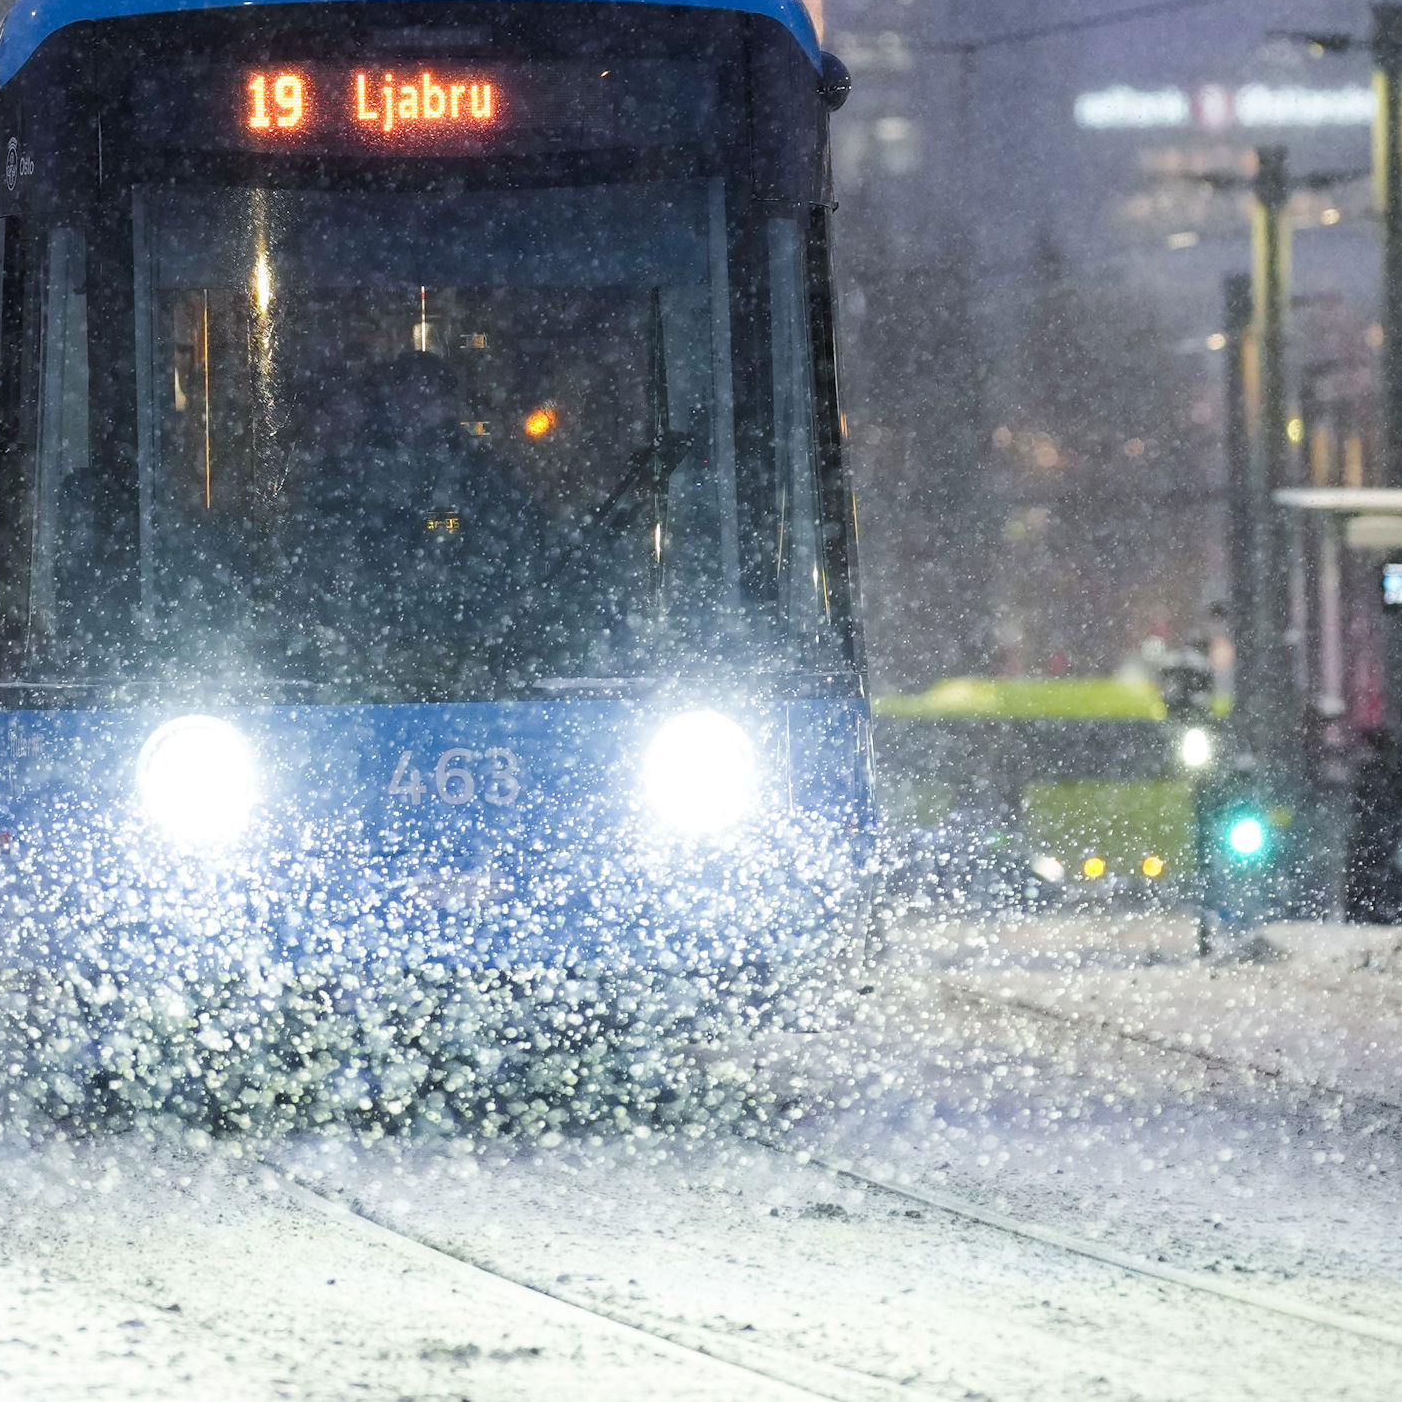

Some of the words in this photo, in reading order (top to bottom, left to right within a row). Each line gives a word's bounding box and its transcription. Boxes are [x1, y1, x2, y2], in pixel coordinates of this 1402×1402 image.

[248, 73, 304, 129] 19
[356, 72, 492, 132] Ljabru
[19, 156, 35, 176] Oslo
[388, 746, 521, 806] 463
